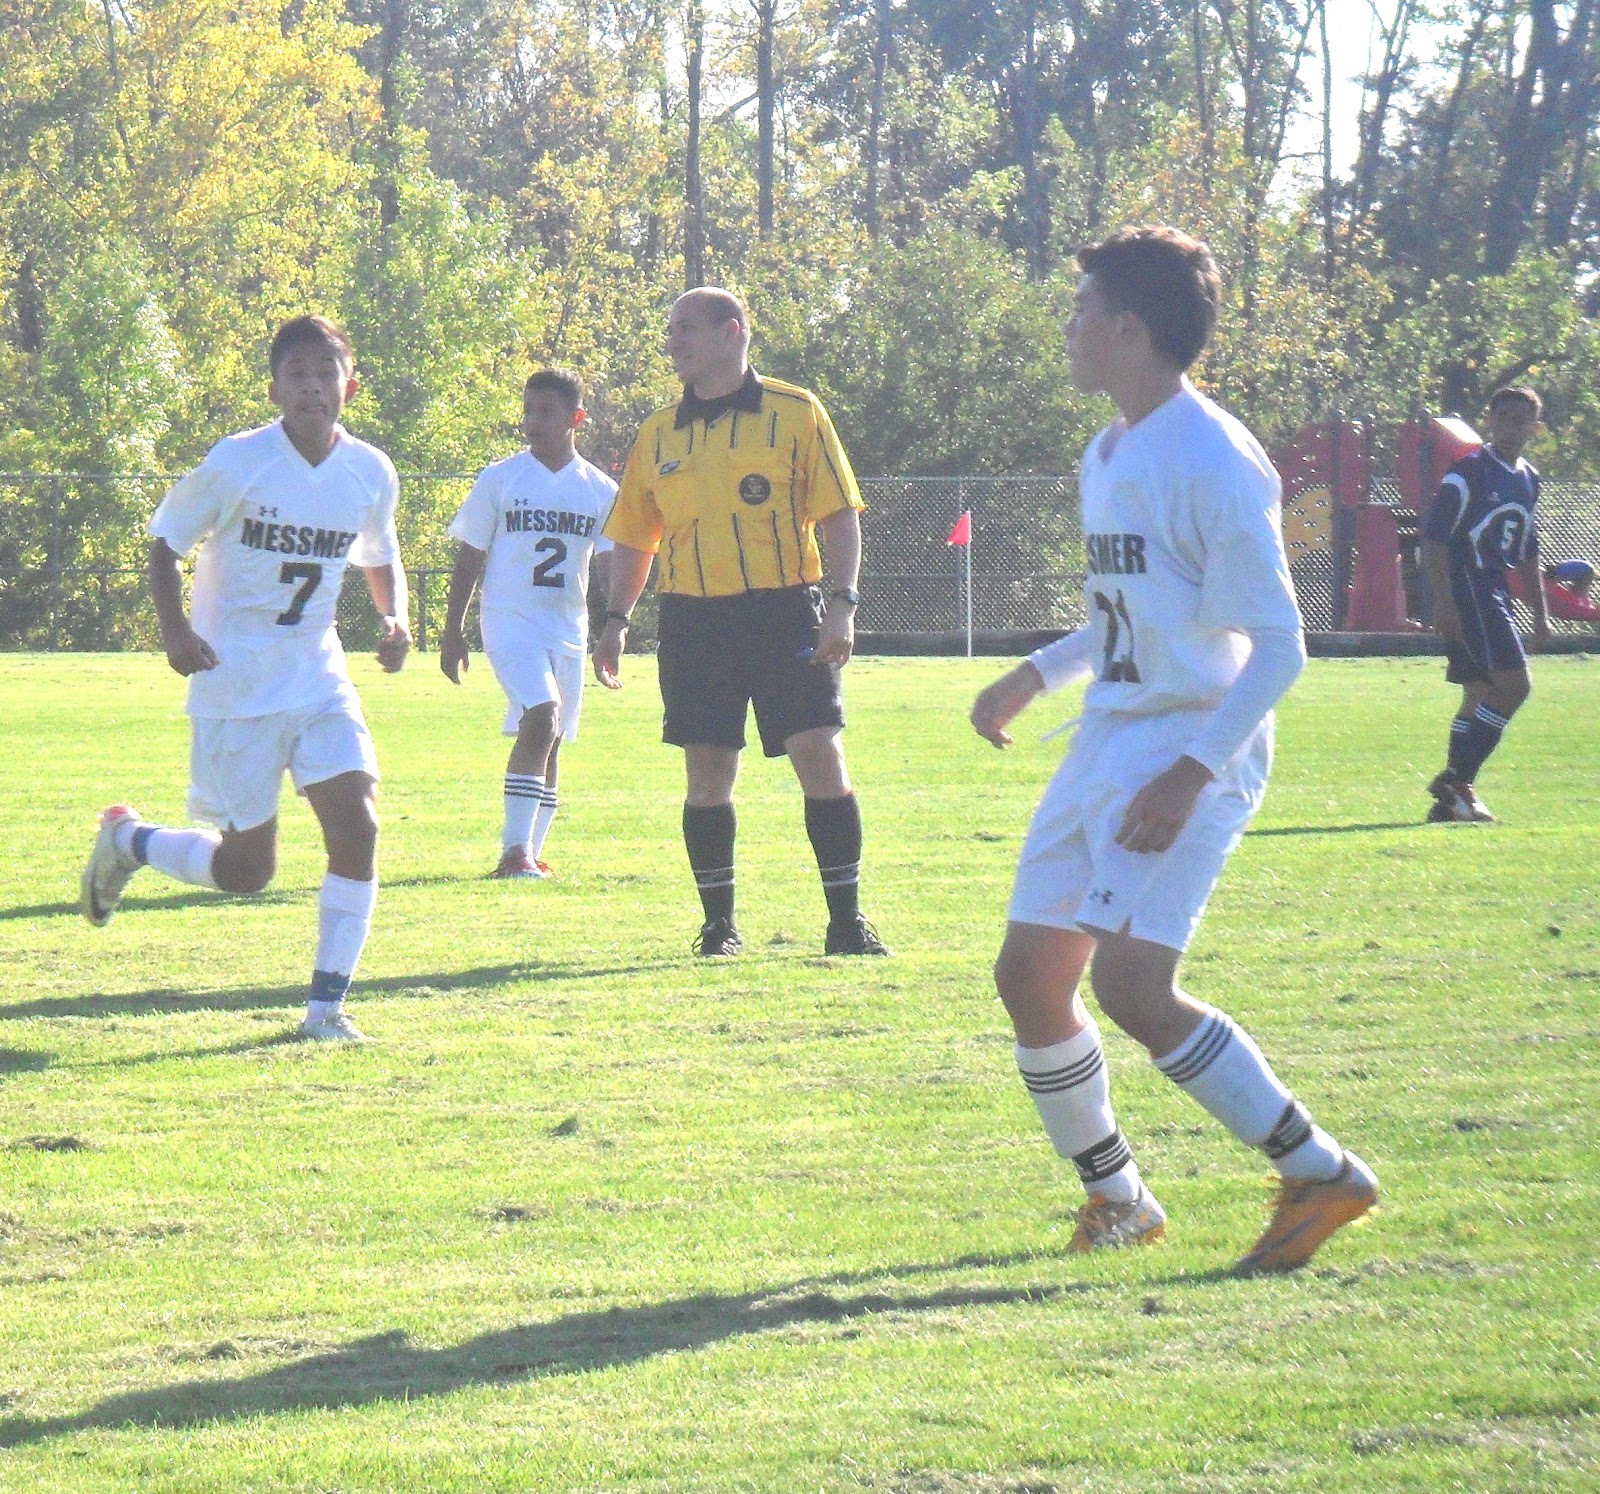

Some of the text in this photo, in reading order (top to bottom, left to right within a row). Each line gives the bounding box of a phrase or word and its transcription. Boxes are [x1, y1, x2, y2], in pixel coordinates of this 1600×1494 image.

[240, 518, 357, 558] MESSME
[505, 509, 595, 537] MESSMER
[1501, 520, 1518, 551] 5
[532, 537, 567, 588] 2
[275, 561, 322, 626] 7
